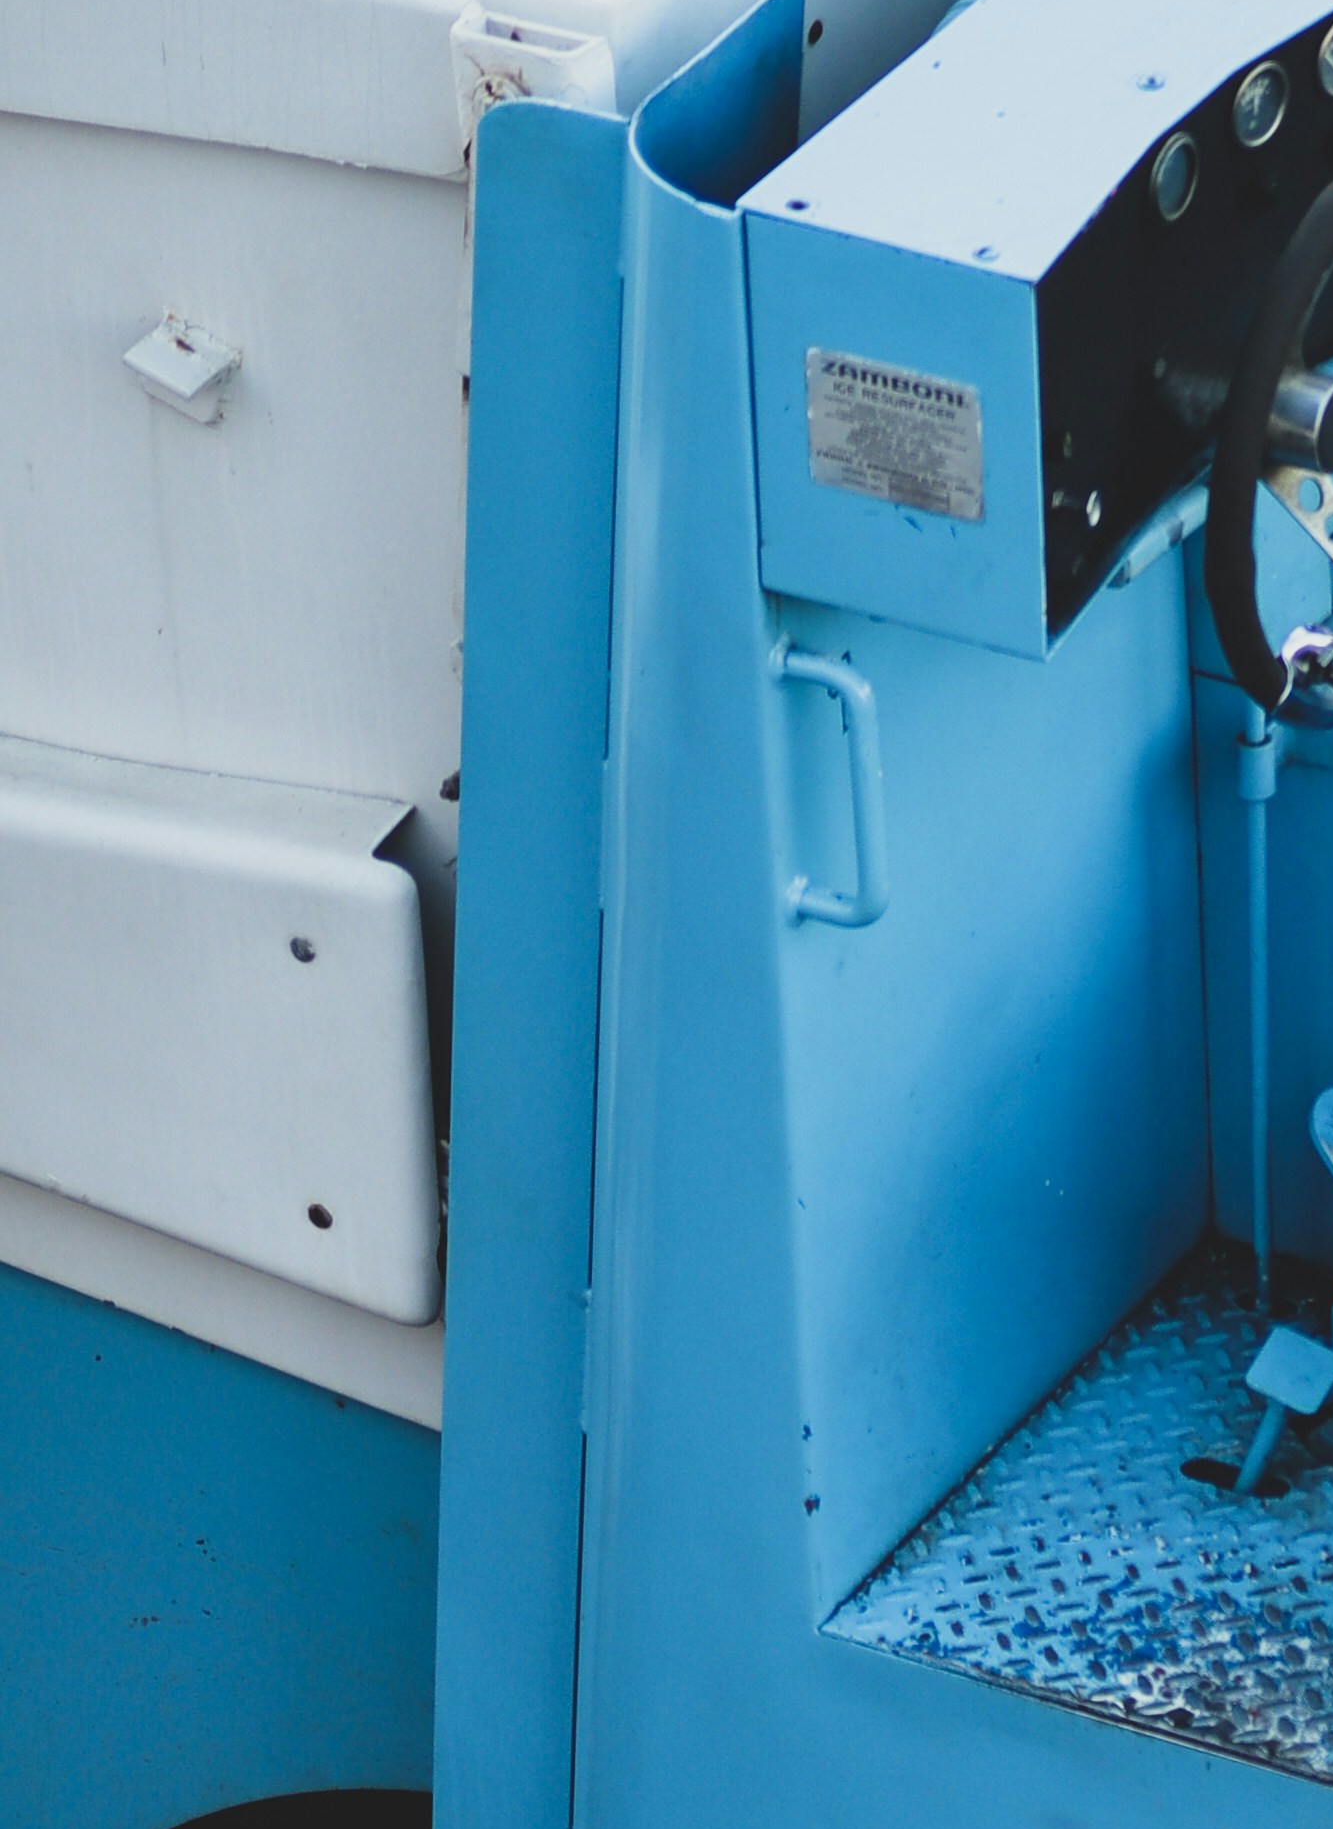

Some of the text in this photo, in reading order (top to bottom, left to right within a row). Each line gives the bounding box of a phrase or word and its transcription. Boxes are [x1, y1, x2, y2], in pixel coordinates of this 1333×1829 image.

[820, 358, 966, 409] ZAMBONI
[832, 381, 956, 421] ICE RESURFACER
